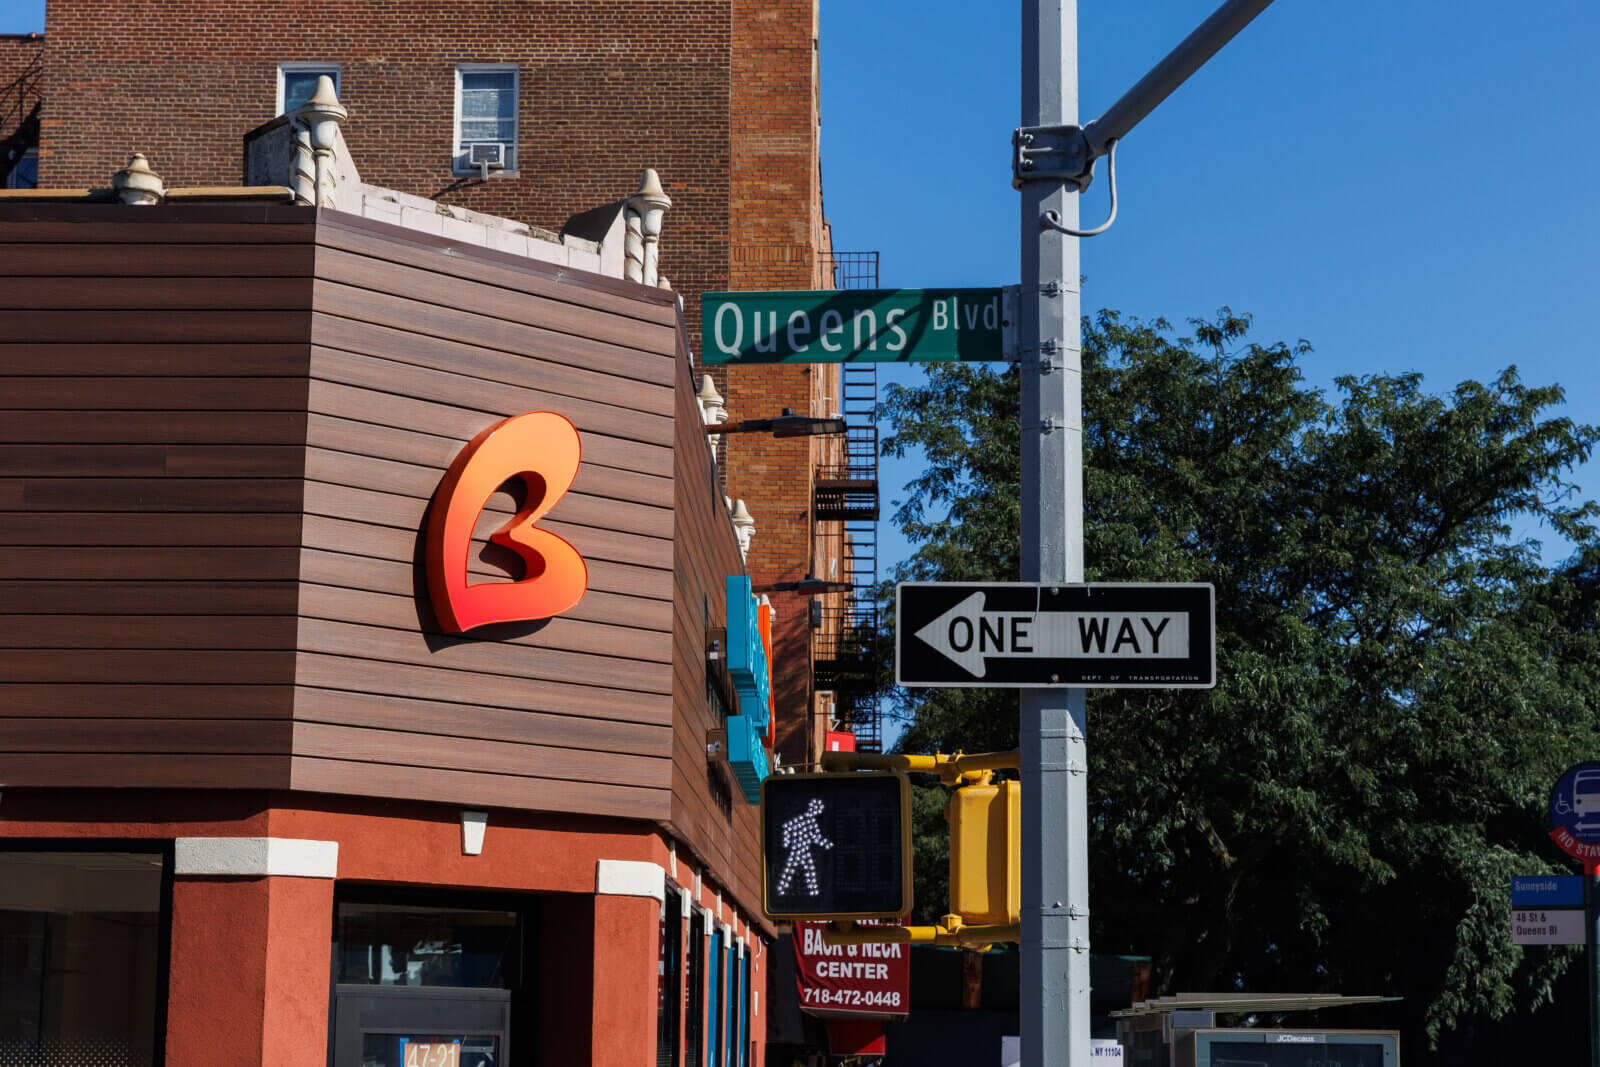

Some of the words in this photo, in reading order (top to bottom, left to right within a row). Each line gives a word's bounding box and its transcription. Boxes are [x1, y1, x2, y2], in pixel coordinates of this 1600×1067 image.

[714, 302, 907, 359] Queens
[932, 296, 999, 331] Blvd
[948, 615, 1034, 653] ONE
[1077, 616, 1171, 654] WAY
[1557, 831, 1574, 849] NO
[1515, 880, 1557, 893] Sunnyside
[1516, 926, 1546, 936] Queens
[816, 961, 889, 980] CENTER
[804, 988, 901, 1007] 718-472-0448
[407, 1043, 457, 1067] 47-21
[1095, 1047, 1104, 1057] NY
[1105, 1047, 1122, 1057] 11104
